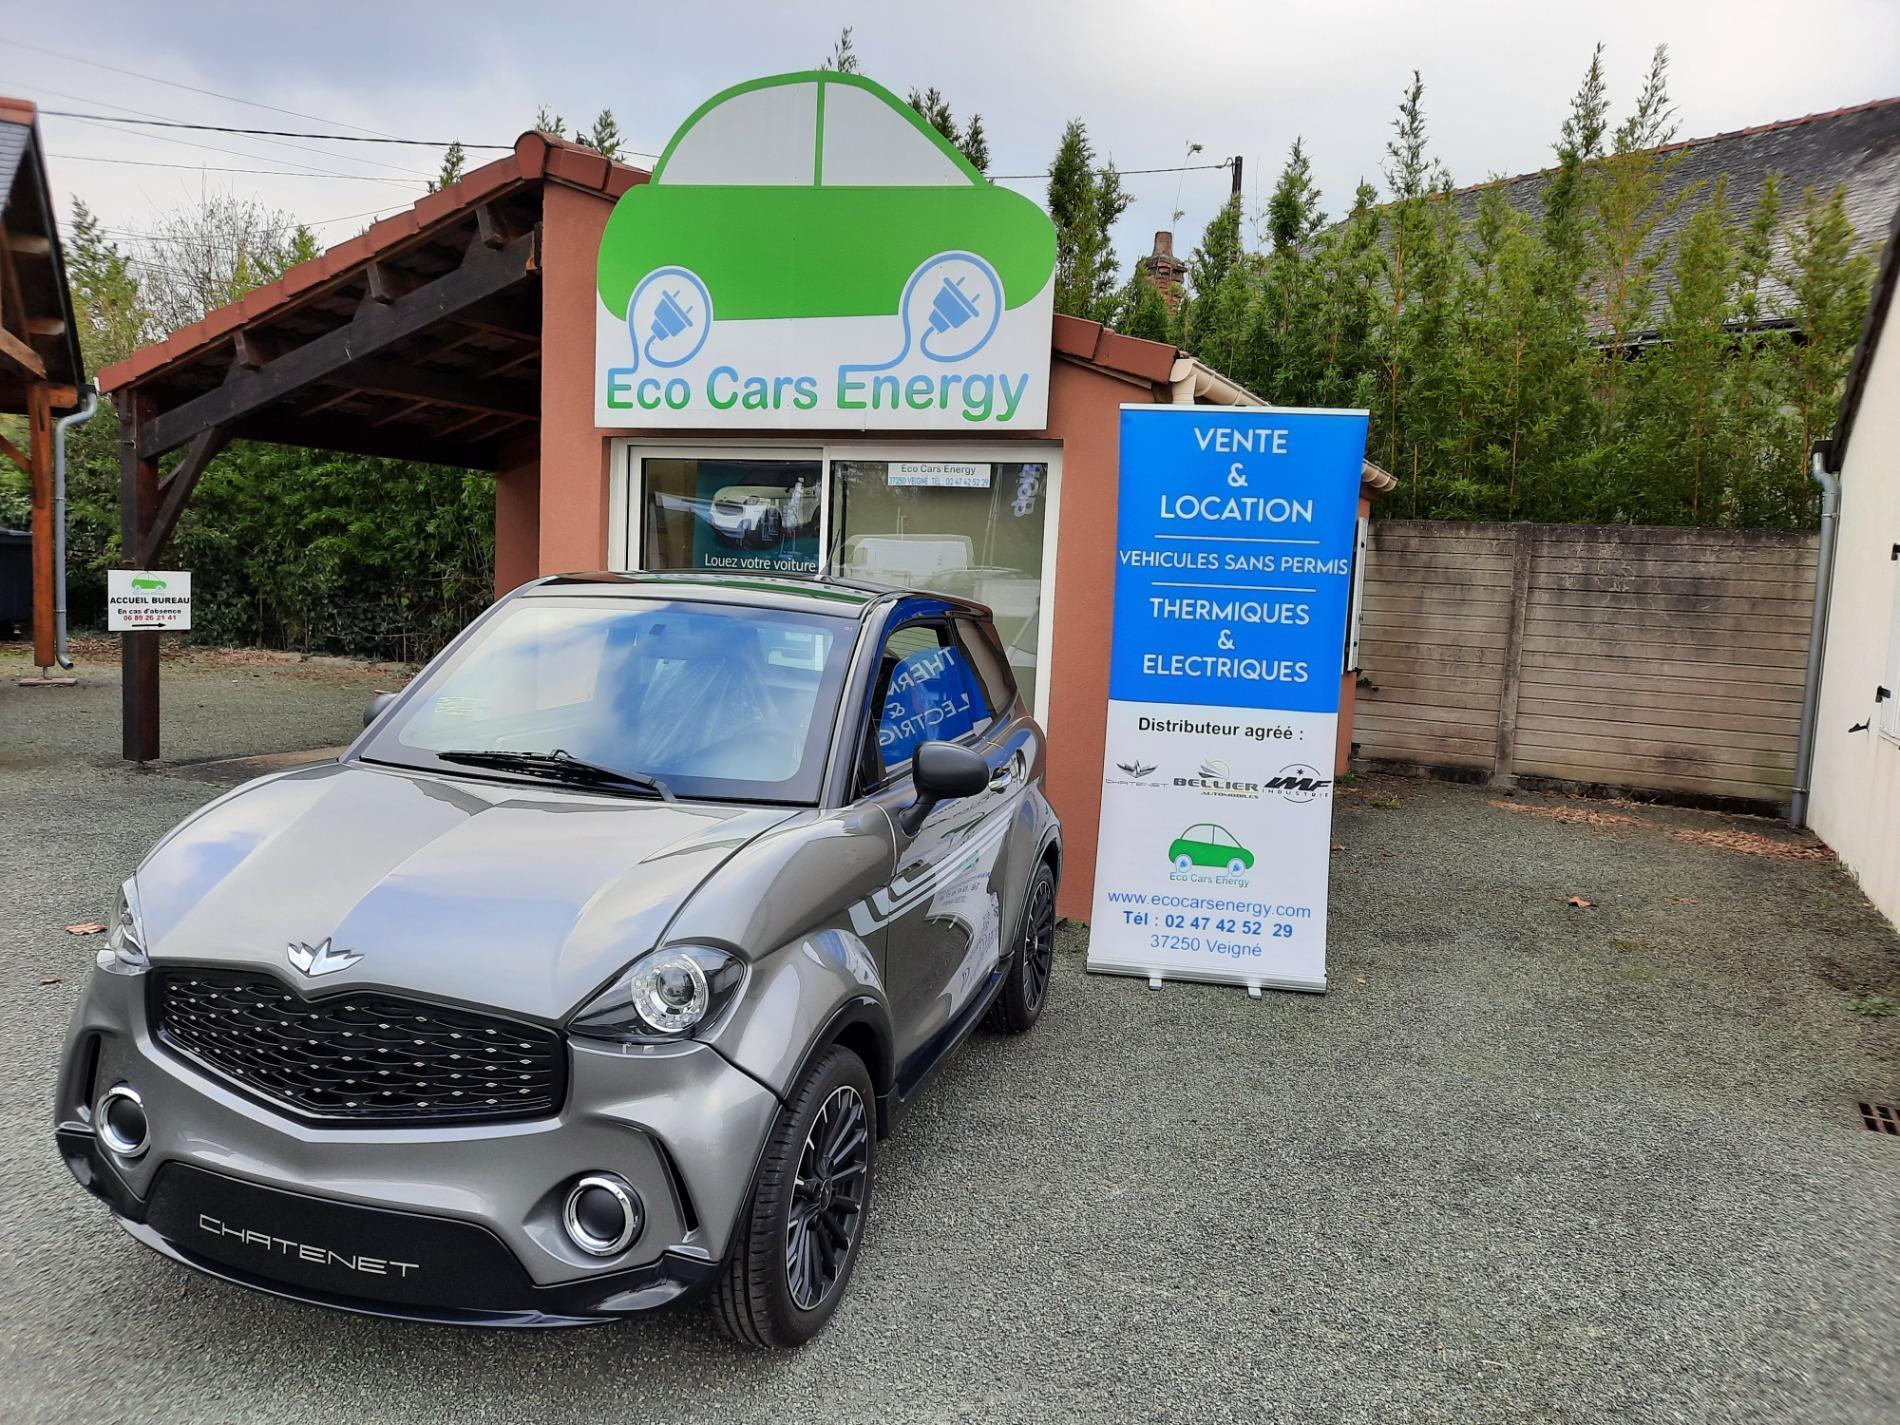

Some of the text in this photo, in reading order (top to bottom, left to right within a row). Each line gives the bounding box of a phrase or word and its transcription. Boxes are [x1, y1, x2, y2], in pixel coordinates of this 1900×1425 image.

[607, 364, 1030, 422] Eco Cars Energy
[1194, 427, 1289, 454] VENTE
[901, 464, 976, 476] Eco Cars Energy
[1227, 462, 1248, 487] &
[1160, 494, 1314, 523] LOCATION
[704, 553, 817, 573] Louez votre voiture
[1119, 550, 1349, 576] VEHICULES SANS PERMIS
[110, 596, 190, 604] ACCUEIL BUREAU
[1150, 597, 1310, 625] THERMIQUES
[1217, 629, 1235, 650] &
[1142, 654, 1310, 683] ELECTRIQUES
[1138, 717, 1240, 737] Distributeur
[1244, 724, 1293, 741] agréé
[1173, 777, 1259, 792] BELLIER
[1200, 790, 1260, 800] AUTOMOBILES
[1262, 788, 1329, 798] INDUSTRIE
[1169, 871, 1250, 888] Eco Cars Energy
[1107, 891, 1312, 919] www.ecocarsenergy.com
[1123, 910, 1149, 926] Tél
[1165, 914, 1185, 929] 02
[1190, 915, 1210, 931] 47
[1216, 917, 1236, 933] 42
[1242, 920, 1262, 936] 52
[1272, 922, 1293, 938] 29
[1149, 934, 1263, 960] 37250 Veigné
[199, 1213, 420, 1277] CHATENET
